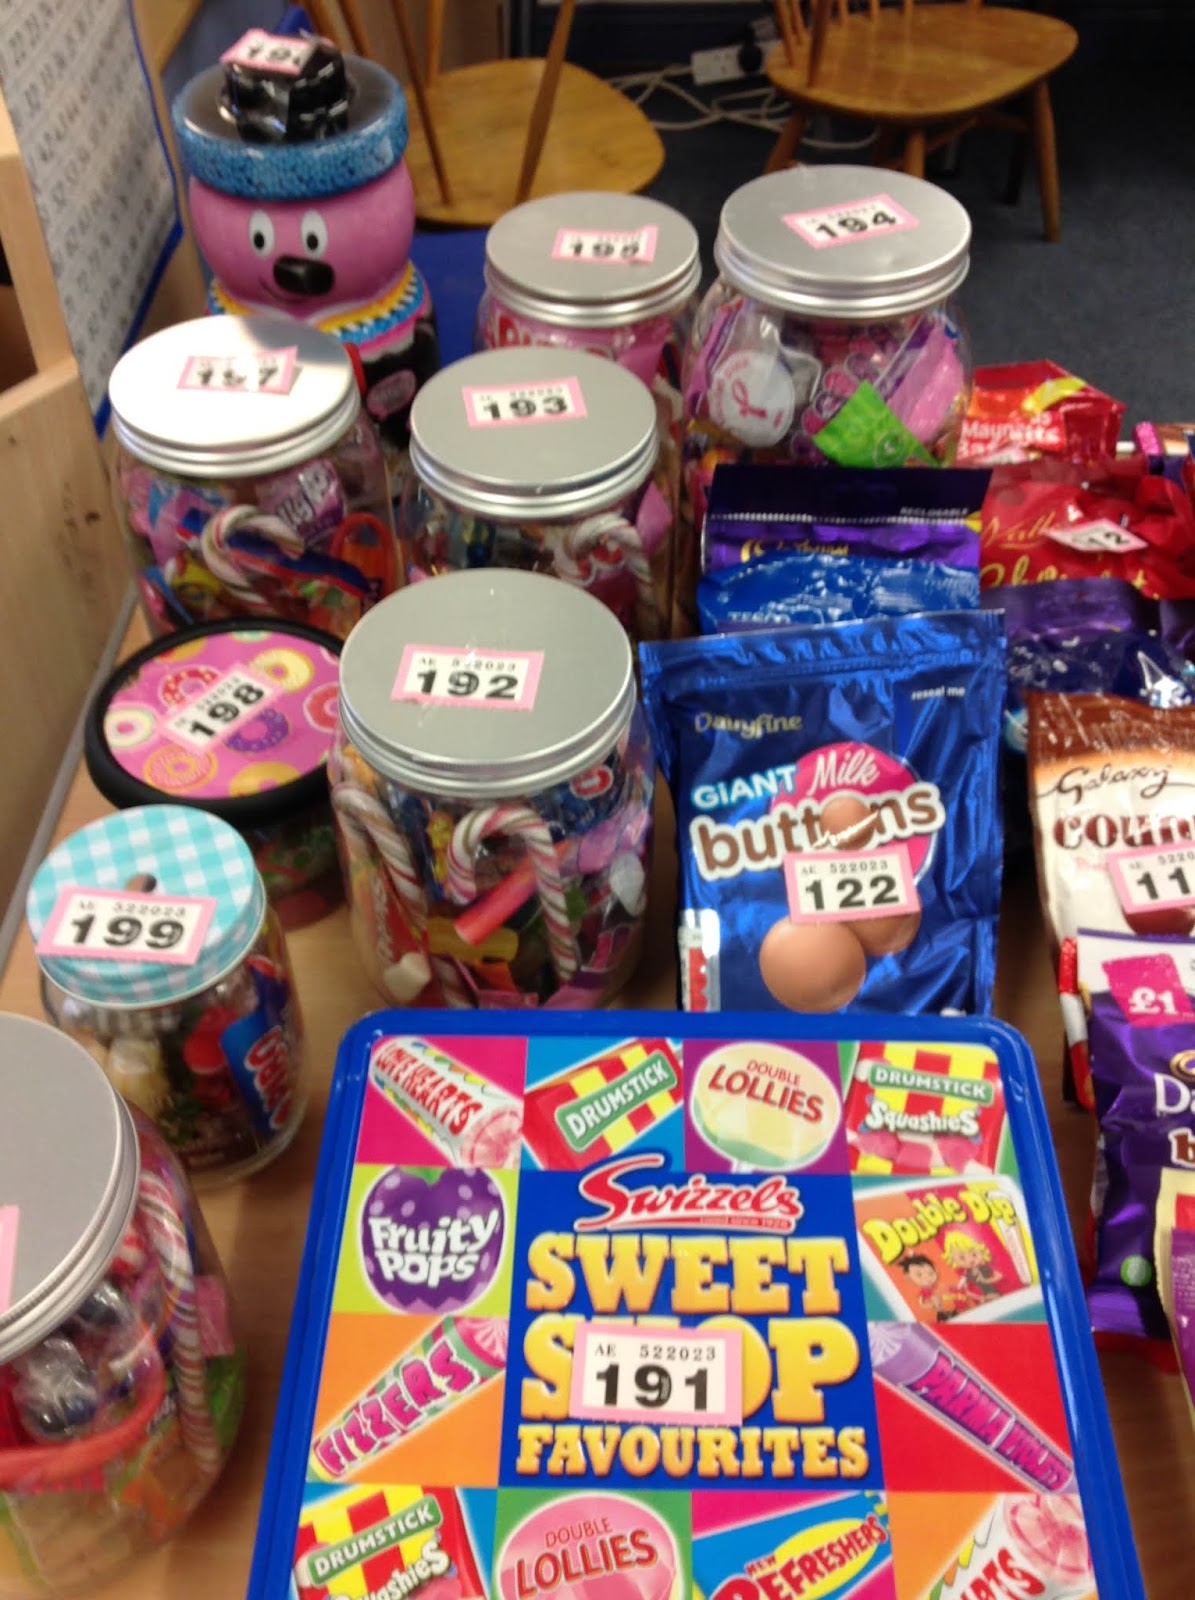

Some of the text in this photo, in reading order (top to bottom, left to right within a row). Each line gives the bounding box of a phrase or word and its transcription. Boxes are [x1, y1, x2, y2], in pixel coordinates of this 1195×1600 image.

[816, 210, 897, 238] 194
[483, 397, 567, 420] 193
[416, 669, 519, 700] 192
[912, 685, 965, 701] reseal me
[190, 683, 265, 736] 198
[807, 749, 880, 797] Milk
[1055, 763, 1170, 804] Galaxy
[829, 859, 888, 874] 522023
[805, 874, 900, 911] 122
[71, 913, 184, 949] 199
[1128, 987, 1179, 1015] £1
[708, 1064, 824, 1124] LOLLIES
[746, 1059, 801, 1087] DOUBLE
[874, 1066, 987, 1100] DRUMSTICK
[401, 1063, 483, 1137] HEARTS
[565, 1058, 670, 1140] DRUMSTICK
[574, 1154, 803, 1232] Swizzels
[367, 1208, 500, 1254] Fruity
[862, 1189, 1016, 1265] Double Dip
[525, 1232, 850, 1316] SWEET
[520, 1311, 860, 1424] SOP
[594, 1342, 717, 1362] AE 522023
[314, 1340, 480, 1477] FIZZERS
[596, 1362, 708, 1412] 191
[515, 1423, 871, 1479] FAVOURITES
[313, 1502, 435, 1578] DRUMSTICK
[544, 1517, 613, 1549] DOUBLE
[516, 1528, 659, 1598] LOLLIES
[709, 1514, 888, 1600] REFRESHERS
[746, 1554, 777, 1576] NEW
